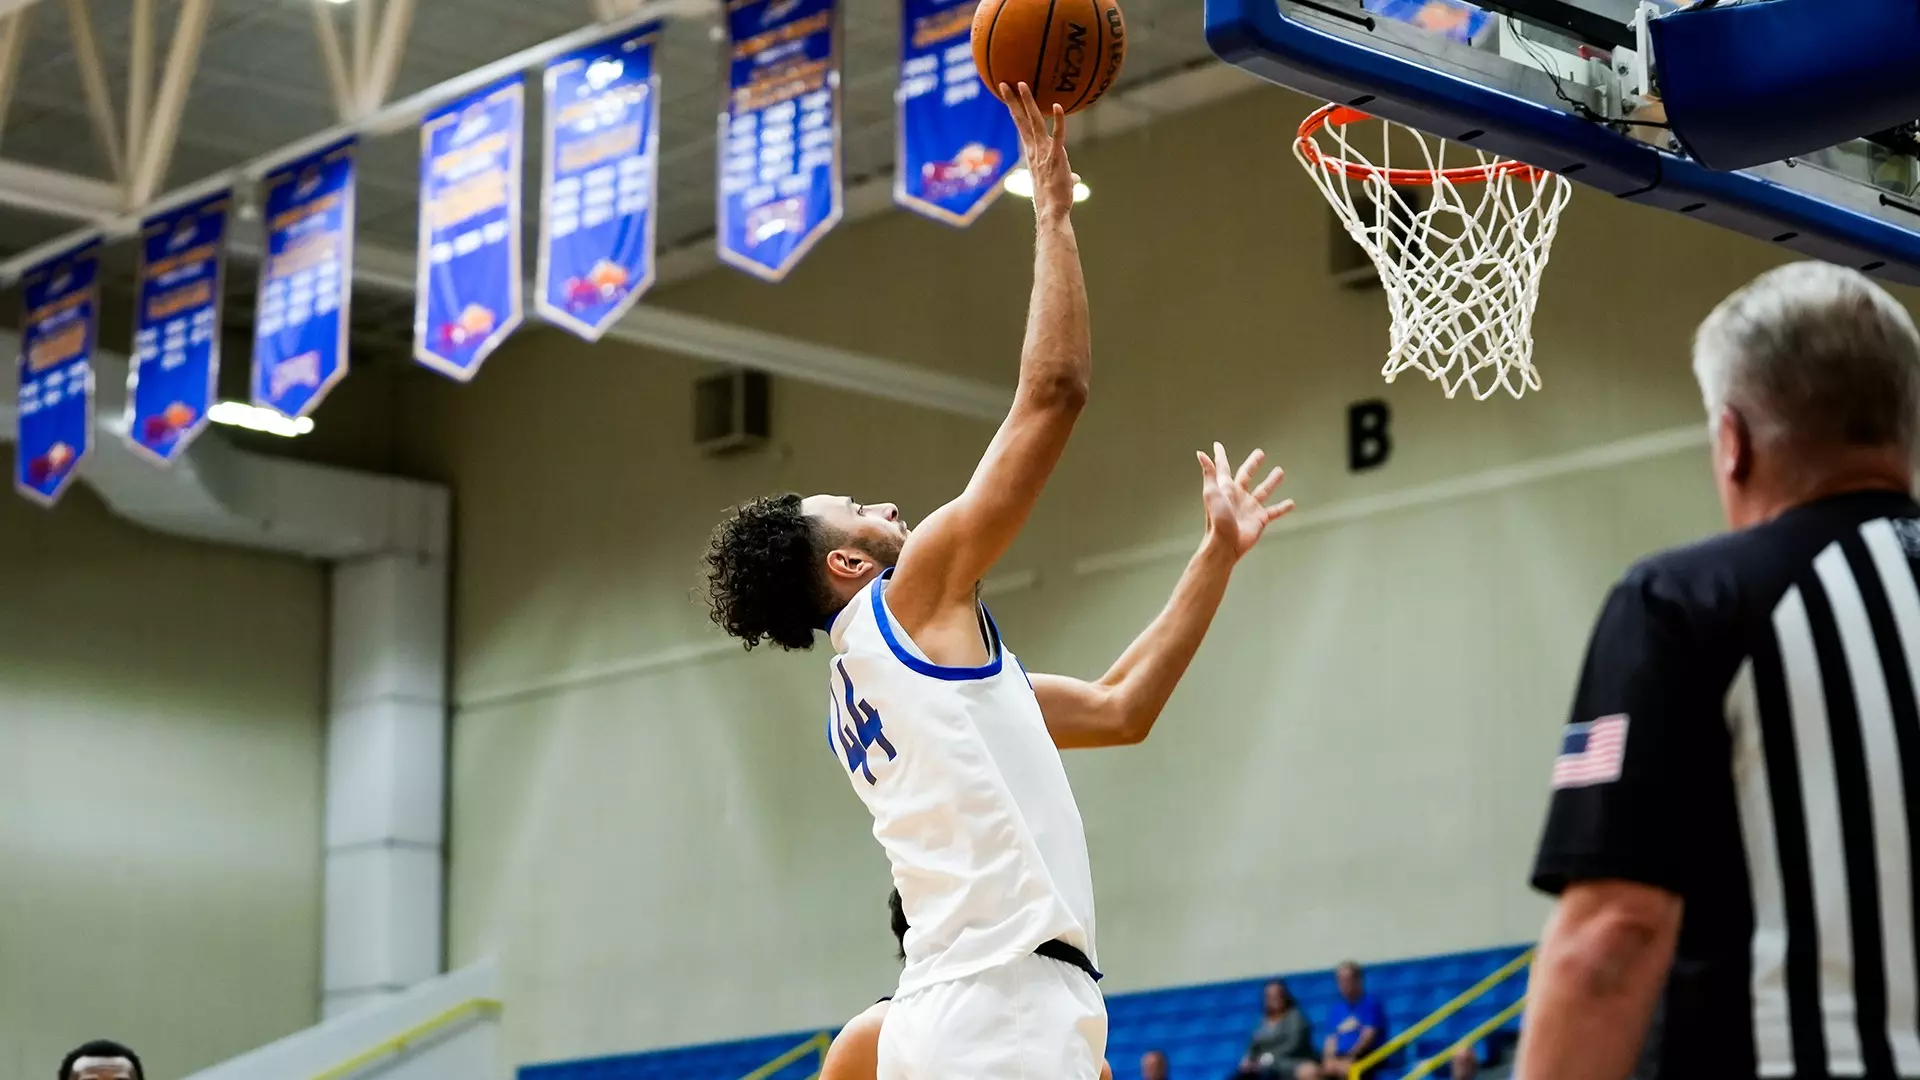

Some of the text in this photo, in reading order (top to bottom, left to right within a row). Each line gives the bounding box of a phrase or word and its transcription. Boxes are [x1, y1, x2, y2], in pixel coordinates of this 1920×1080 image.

[1055, 22, 1087, 91] NCAA
[1346, 399, 1392, 473] B
[829, 658, 897, 786] 44
